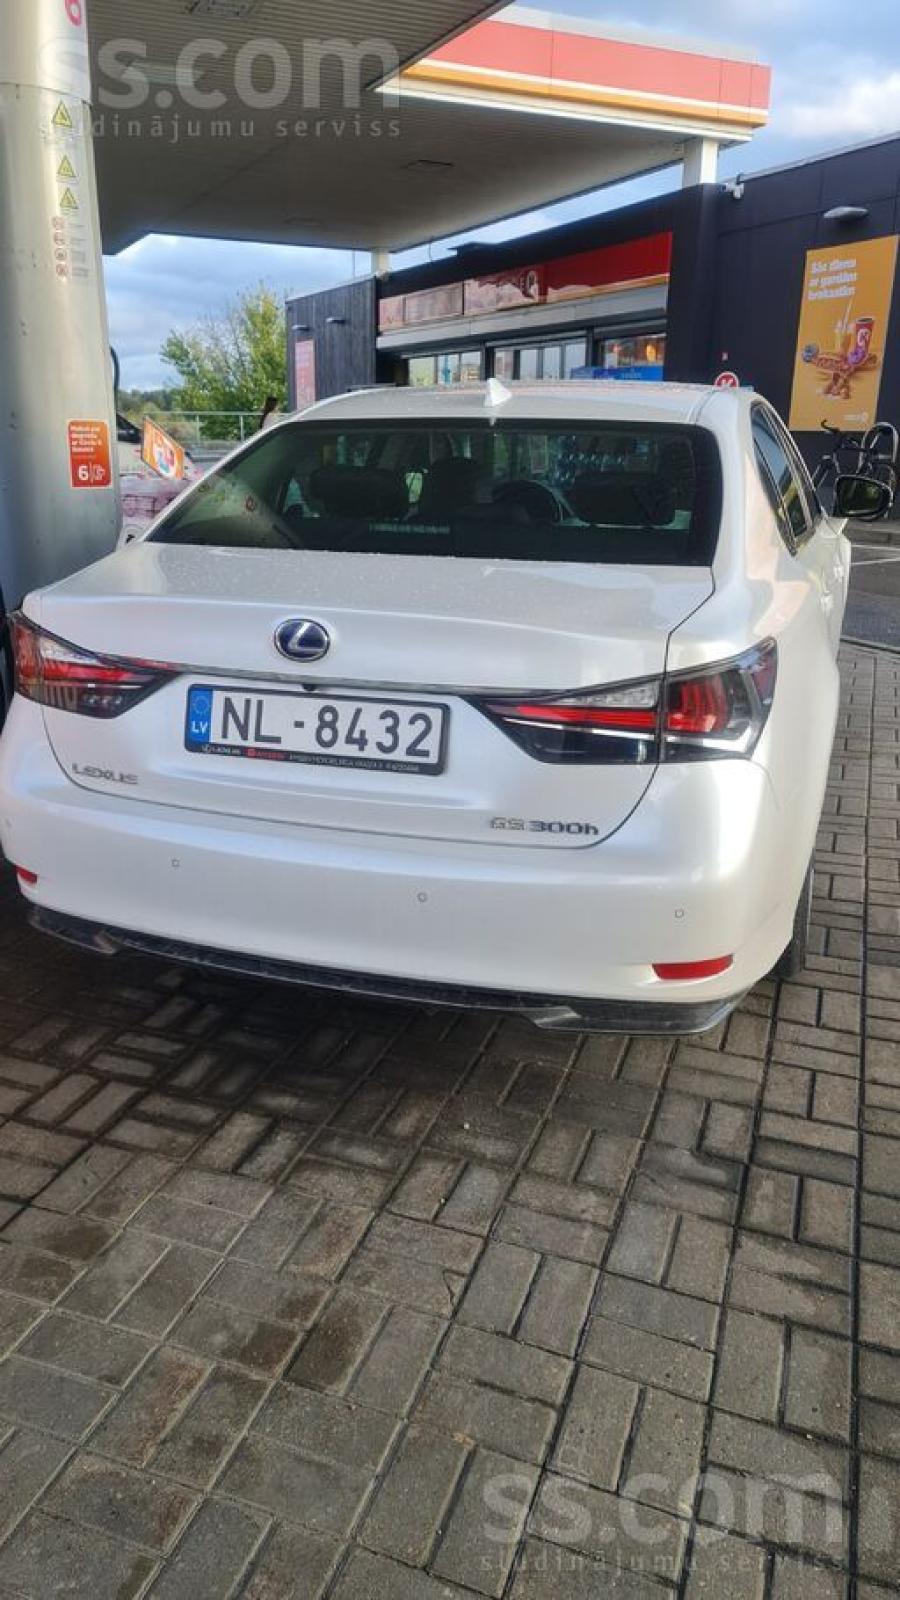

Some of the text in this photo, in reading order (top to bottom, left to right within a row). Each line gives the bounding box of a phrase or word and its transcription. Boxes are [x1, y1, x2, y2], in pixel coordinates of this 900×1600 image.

[79, 464, 89, 480] 6
[190, 721, 208, 734] LV
[221, 696, 433, 757] NL-8432
[72, 763, 138, 785] LEXUS
[490, 817, 599, 836] GS 300h
